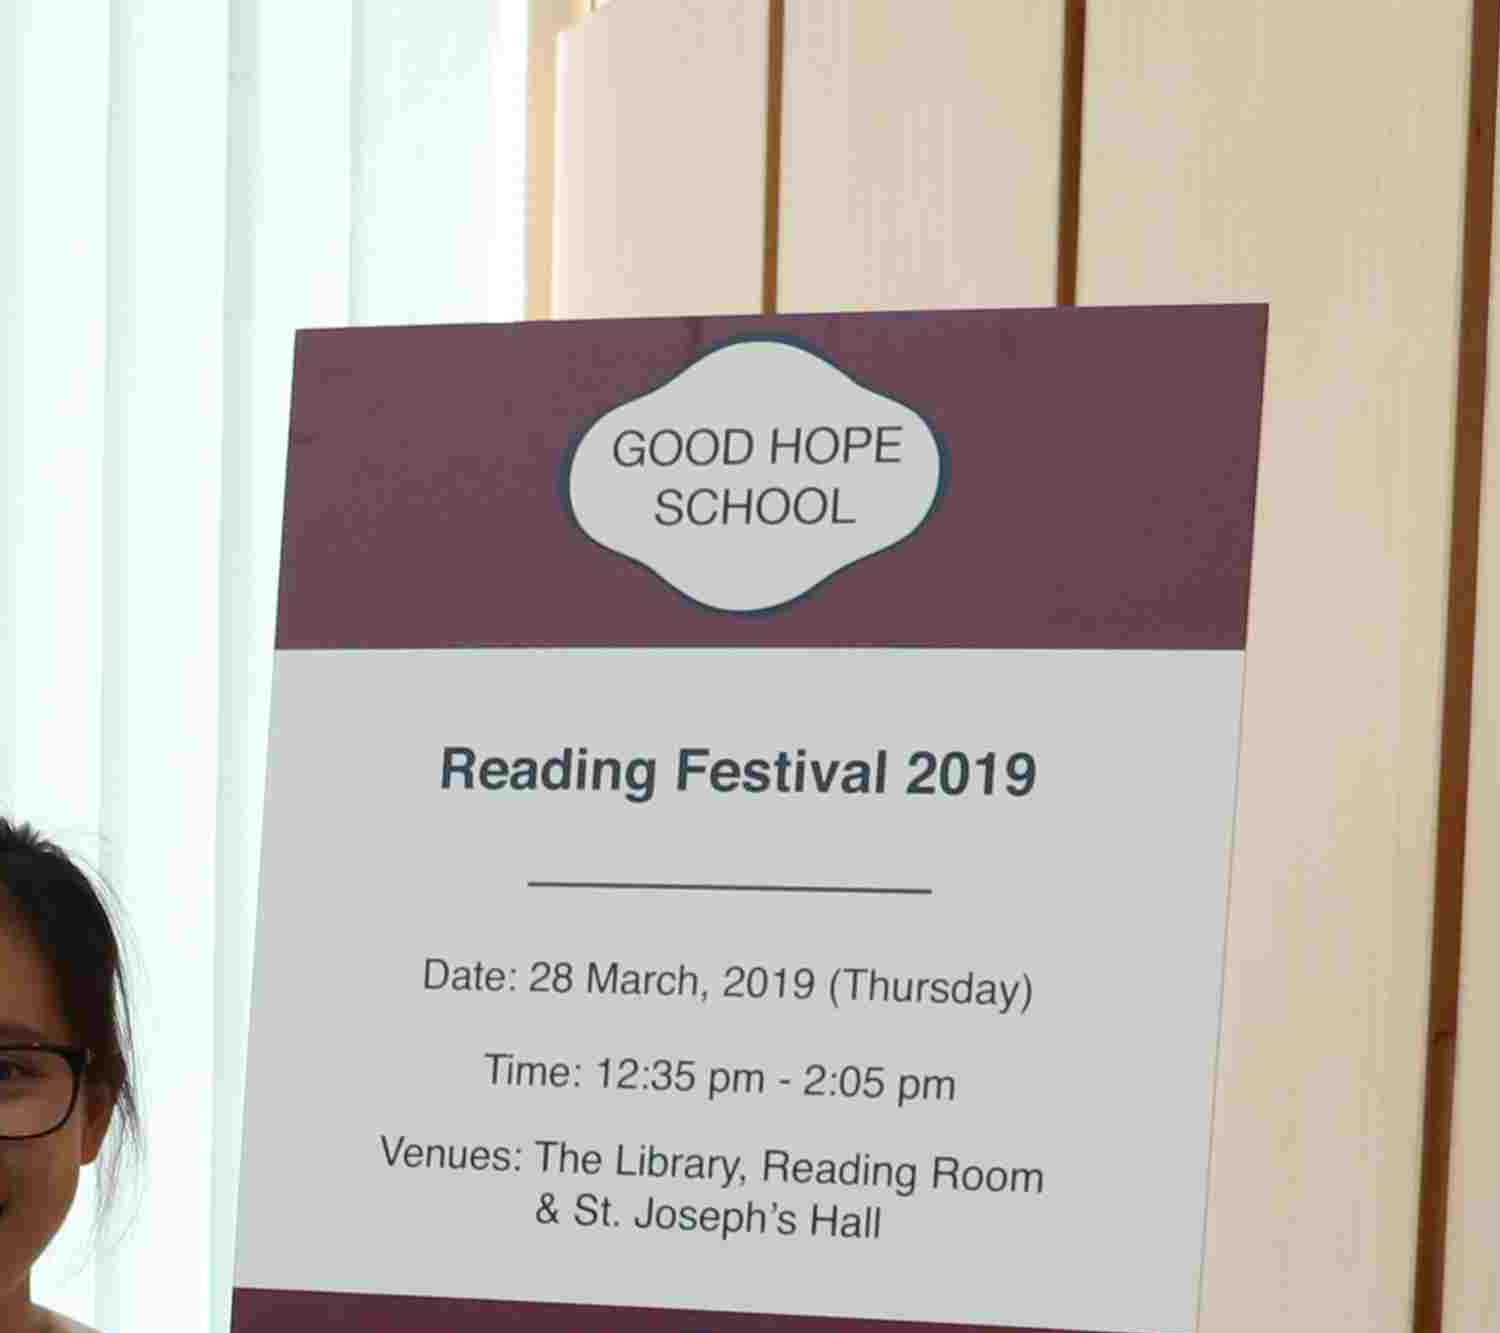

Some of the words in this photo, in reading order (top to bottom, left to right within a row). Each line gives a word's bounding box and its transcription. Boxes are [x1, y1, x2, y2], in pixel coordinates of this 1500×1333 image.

[613, 428, 754, 467] GOOD
[771, 425, 903, 465] HOPE
[655, 486, 857, 526] SCHOOL
[441, 746, 656, 804] Reading
[677, 748, 887, 794] Festival
[906, 751, 1036, 797] 2019
[424, 958, 516, 992] Date:
[529, 961, 573, 994] 28
[587, 961, 707, 1001] March,
[723, 965, 815, 1000] 2019
[829, 967, 1033, 1015] (Thursday)
[484, 1052, 581, 1088] Time:
[598, 1057, 696, 1092] 12:35
[708, 1067, 765, 1101] pm
[803, 1063, 885, 1099] 2:05
[897, 1074, 955, 1108] pm
[380, 1135, 521, 1172] Venues:
[535, 1140, 602, 1175] The
[616, 1143, 746, 1189] Library,
[763, 1149, 917, 1197] Reading
[932, 1156, 1043, 1193] Room
[535, 1192, 559, 1225] &
[574, 1193, 619, 1227] St.
[634, 1196, 797, 1241] Joseph's
[811, 1203, 881, 1239] Hall
